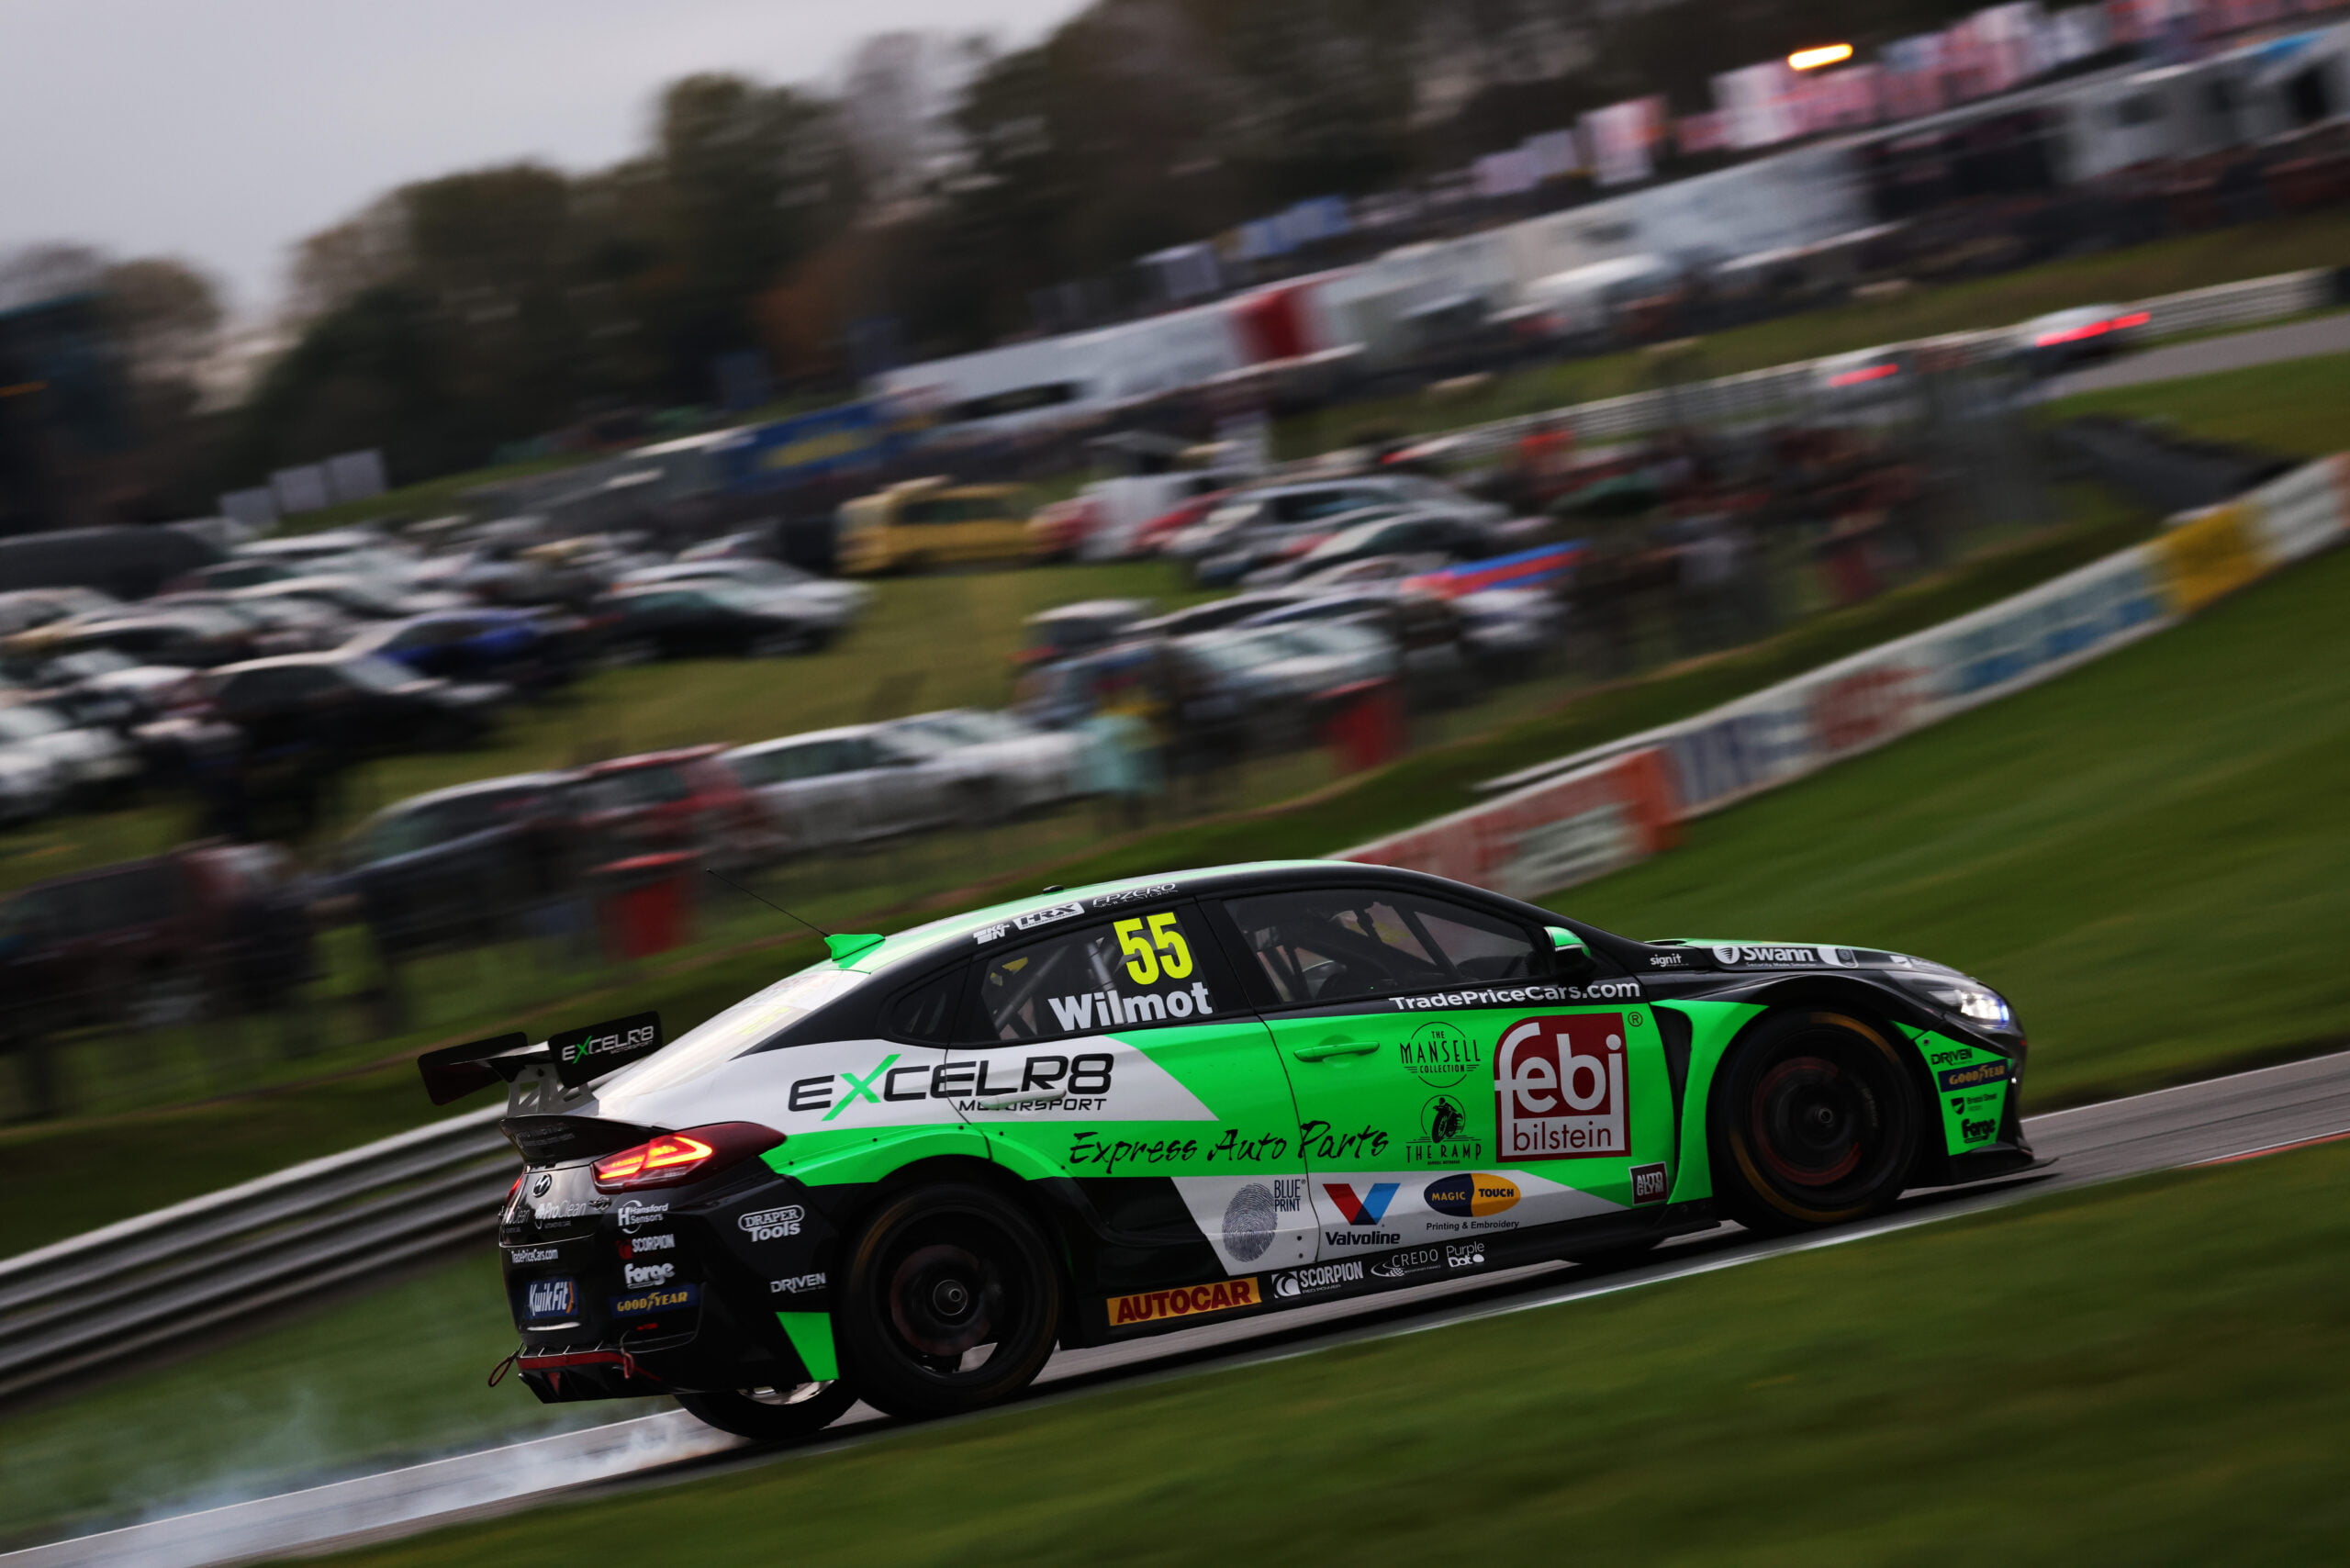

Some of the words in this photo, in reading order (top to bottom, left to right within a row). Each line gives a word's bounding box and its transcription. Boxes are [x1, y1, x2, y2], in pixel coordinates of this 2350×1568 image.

[1113, 912, 1193, 985] 55
[1741, 946, 1815, 962] Swann
[1650, 953, 1682, 968] signit
[1389, 982, 1640, 1011] TradePriceCars.com
[1048, 981, 1213, 1032] Wilmot
[1431, 1030, 1445, 1039] THE
[562, 1025, 655, 1065] EXCELR8
[1399, 1039, 1481, 1064] MANSELL
[1930, 1047, 1973, 1066] DRIVEN
[1419, 1064, 1465, 1074] COLLECTION
[1494, 1022, 1622, 1113] febi
[789, 1053, 1114, 1122] EXCELR8
[1514, 1121, 1612, 1151] bilstein
[1069, 1131, 1198, 1174] Express
[1207, 1129, 1287, 1161] Auto
[1297, 1120, 1390, 1159] Parts
[1406, 1143, 1432, 1163] THE
[1440, 1142, 1482, 1161] RAMP
[1432, 1192, 1466, 1202] MAGIC
[1479, 1188, 1515, 1198] TOUCH
[1274, 1198, 1301, 1213] PRINT
[744, 1208, 799, 1227] DRAPER
[1427, 1222, 1460, 1231] Printing
[1462, 1221, 1468, 1229] &
[1471, 1220, 1520, 1230] Embroidery
[632, 1234, 676, 1253] SCORPION
[1326, 1231, 1401, 1246] Valvoline
[511, 1249, 558, 1264] TradePriceCars.com
[1392, 1249, 1438, 1268] CREDO
[1446, 1241, 1485, 1258] Purple
[1448, 1255, 1472, 1268] Dot
[769, 1272, 827, 1294] DRIVEN
[1299, 1260, 1364, 1288] SCORPION
[617, 1291, 688, 1313] GOODYEAR
[1116, 1281, 1252, 1324] AUTOCAR
